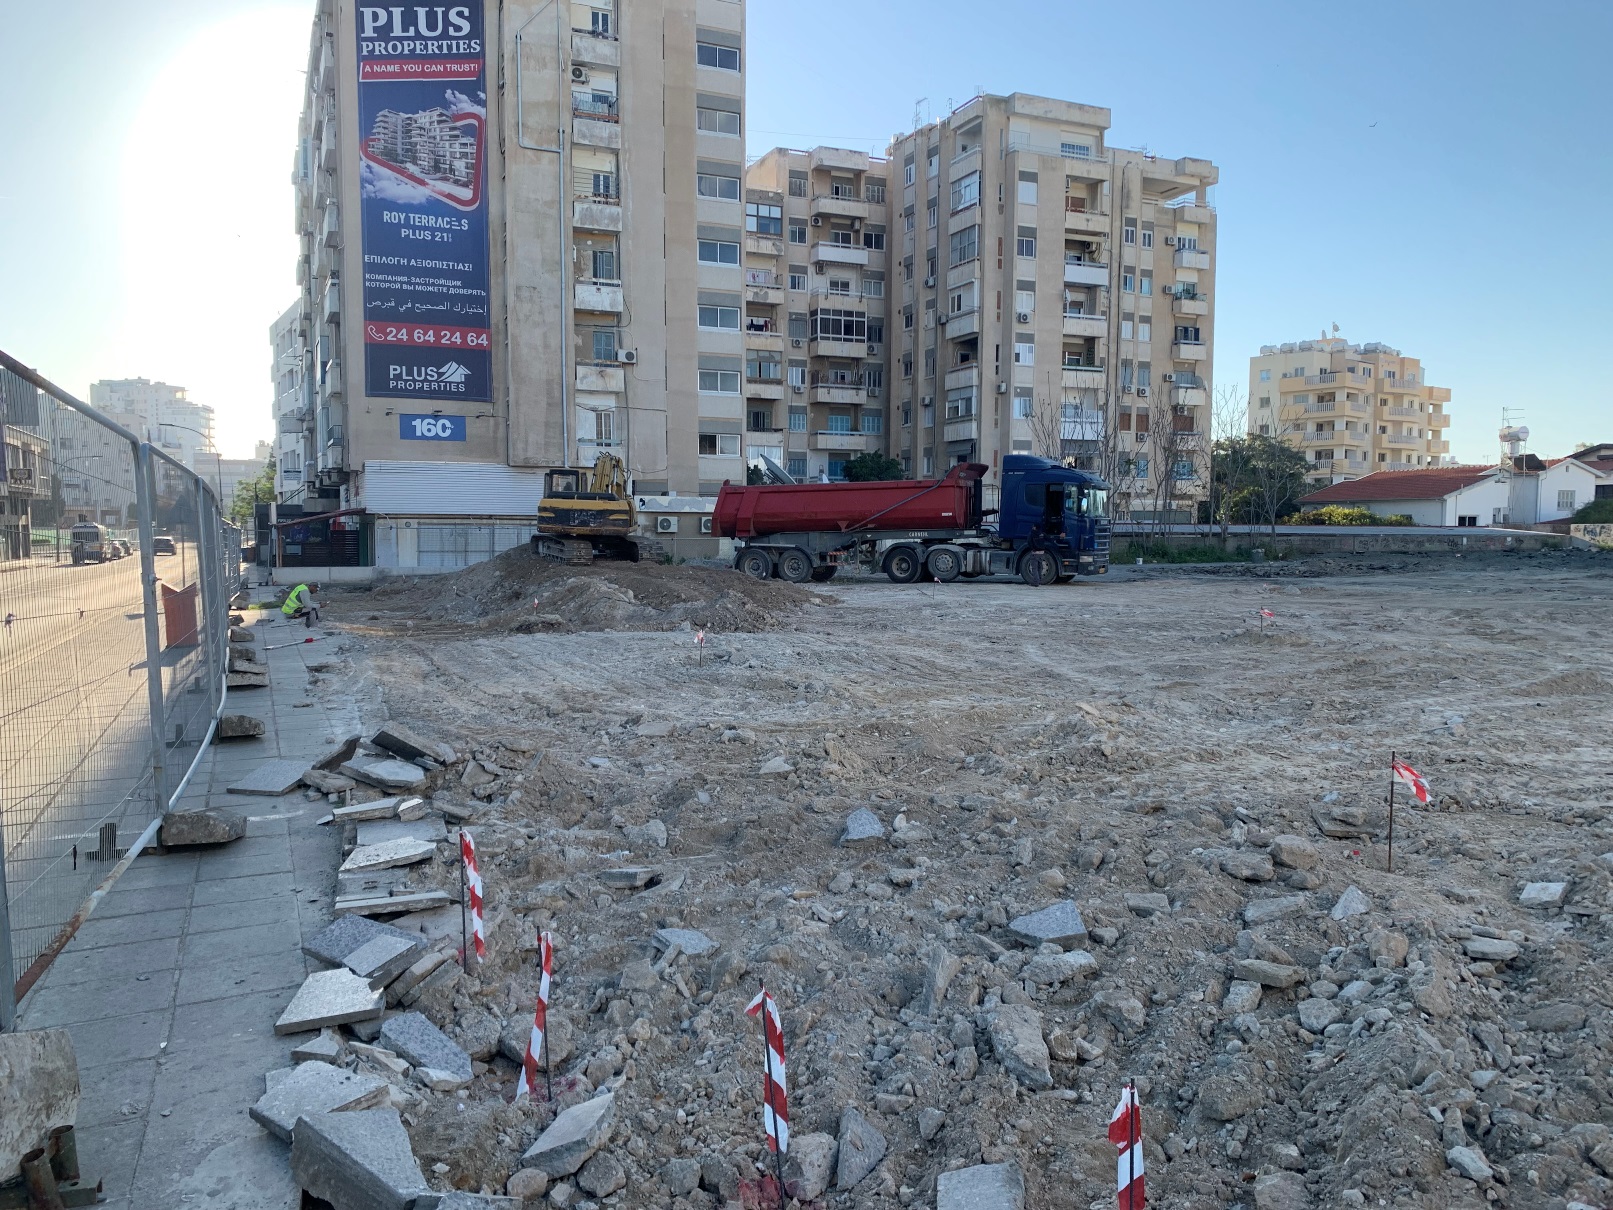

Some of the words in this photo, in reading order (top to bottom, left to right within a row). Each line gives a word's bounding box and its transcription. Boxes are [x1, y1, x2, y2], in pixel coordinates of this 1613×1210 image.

[360, 6, 471, 37] PLUS
[361, 39, 481, 55] PROPERTIES
[364, 64, 372, 73] A
[373, 64, 401, 73] NAME
[402, 64, 422, 72] YOU
[424, 64, 444, 72] CAN
[445, 63, 478, 72] TRUST!
[383, 211, 406, 224] ROY
[408, 213, 469, 231] TERRACES
[401, 228, 432, 240] PLUS
[364, 254, 408, 266] ΕΠΙΛΟΓΗ
[410, 258, 473, 271] ΑΞΙΟΠΙΣΤΙΑΣ!
[365, 273, 462, 287] КОМПАНИЯ-ЗАСТРОЙЩИК
[365, 281, 401, 290] КОТОРОЙ
[415, 285, 448, 293] МОЖЕТЕ
[448, 287, 487, 296] ДОВЕРЯТЬ
[366, 298, 396, 309] قبرص
[398, 299, 412, 312] في
[414, 301, 450, 312] الصحيح
[386, 327, 408, 341] 24
[413, 329, 435, 343] 64
[440, 331, 462, 345] 24
[467, 332, 488, 347] 64
[389, 365, 438, 380] PLUS
[389, 381, 466, 392] PROPERTIES
[411, 418, 452, 438] 160
